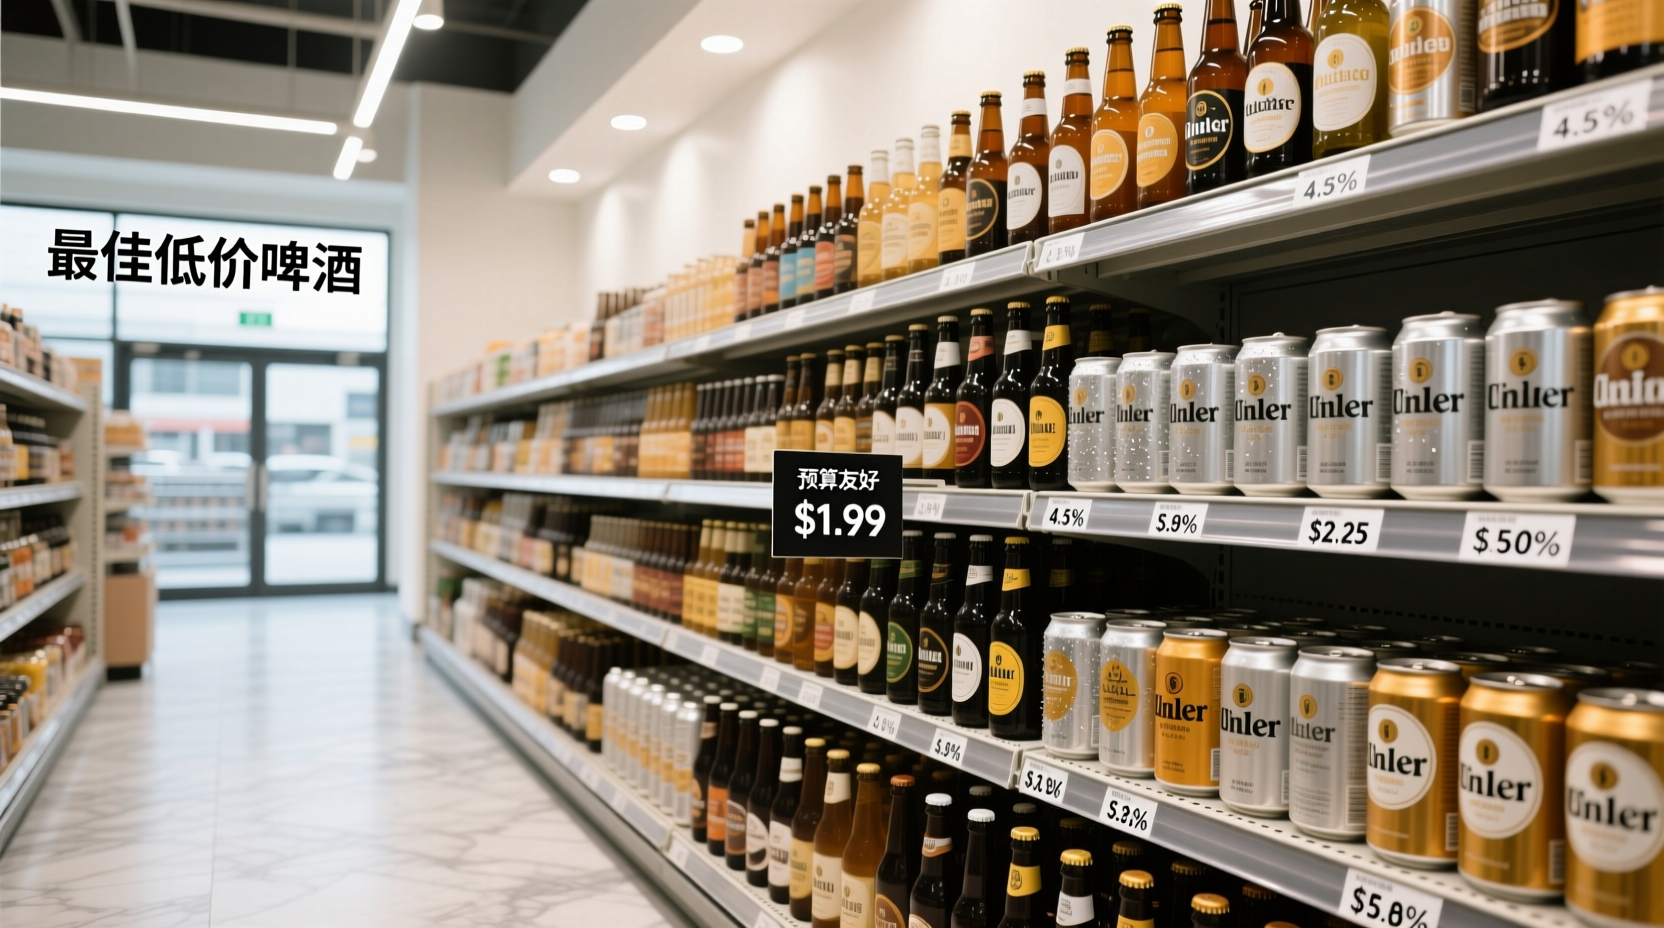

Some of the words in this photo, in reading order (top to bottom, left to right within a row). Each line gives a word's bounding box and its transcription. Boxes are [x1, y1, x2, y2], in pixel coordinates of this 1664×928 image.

[1553, 99, 1634, 139] 4.5%
[1303, 170, 1357, 200] 4.5%
[48, 229, 362, 294] 最佳低价啤酒
[797, 467, 880, 491] 预算友好
[794, 499, 886, 539] $1.99
[1049, 507, 1084, 527] 4.5%
[1308, 517, 1370, 545] $2.25
[1350, 884, 1428, 928] $5.8%
